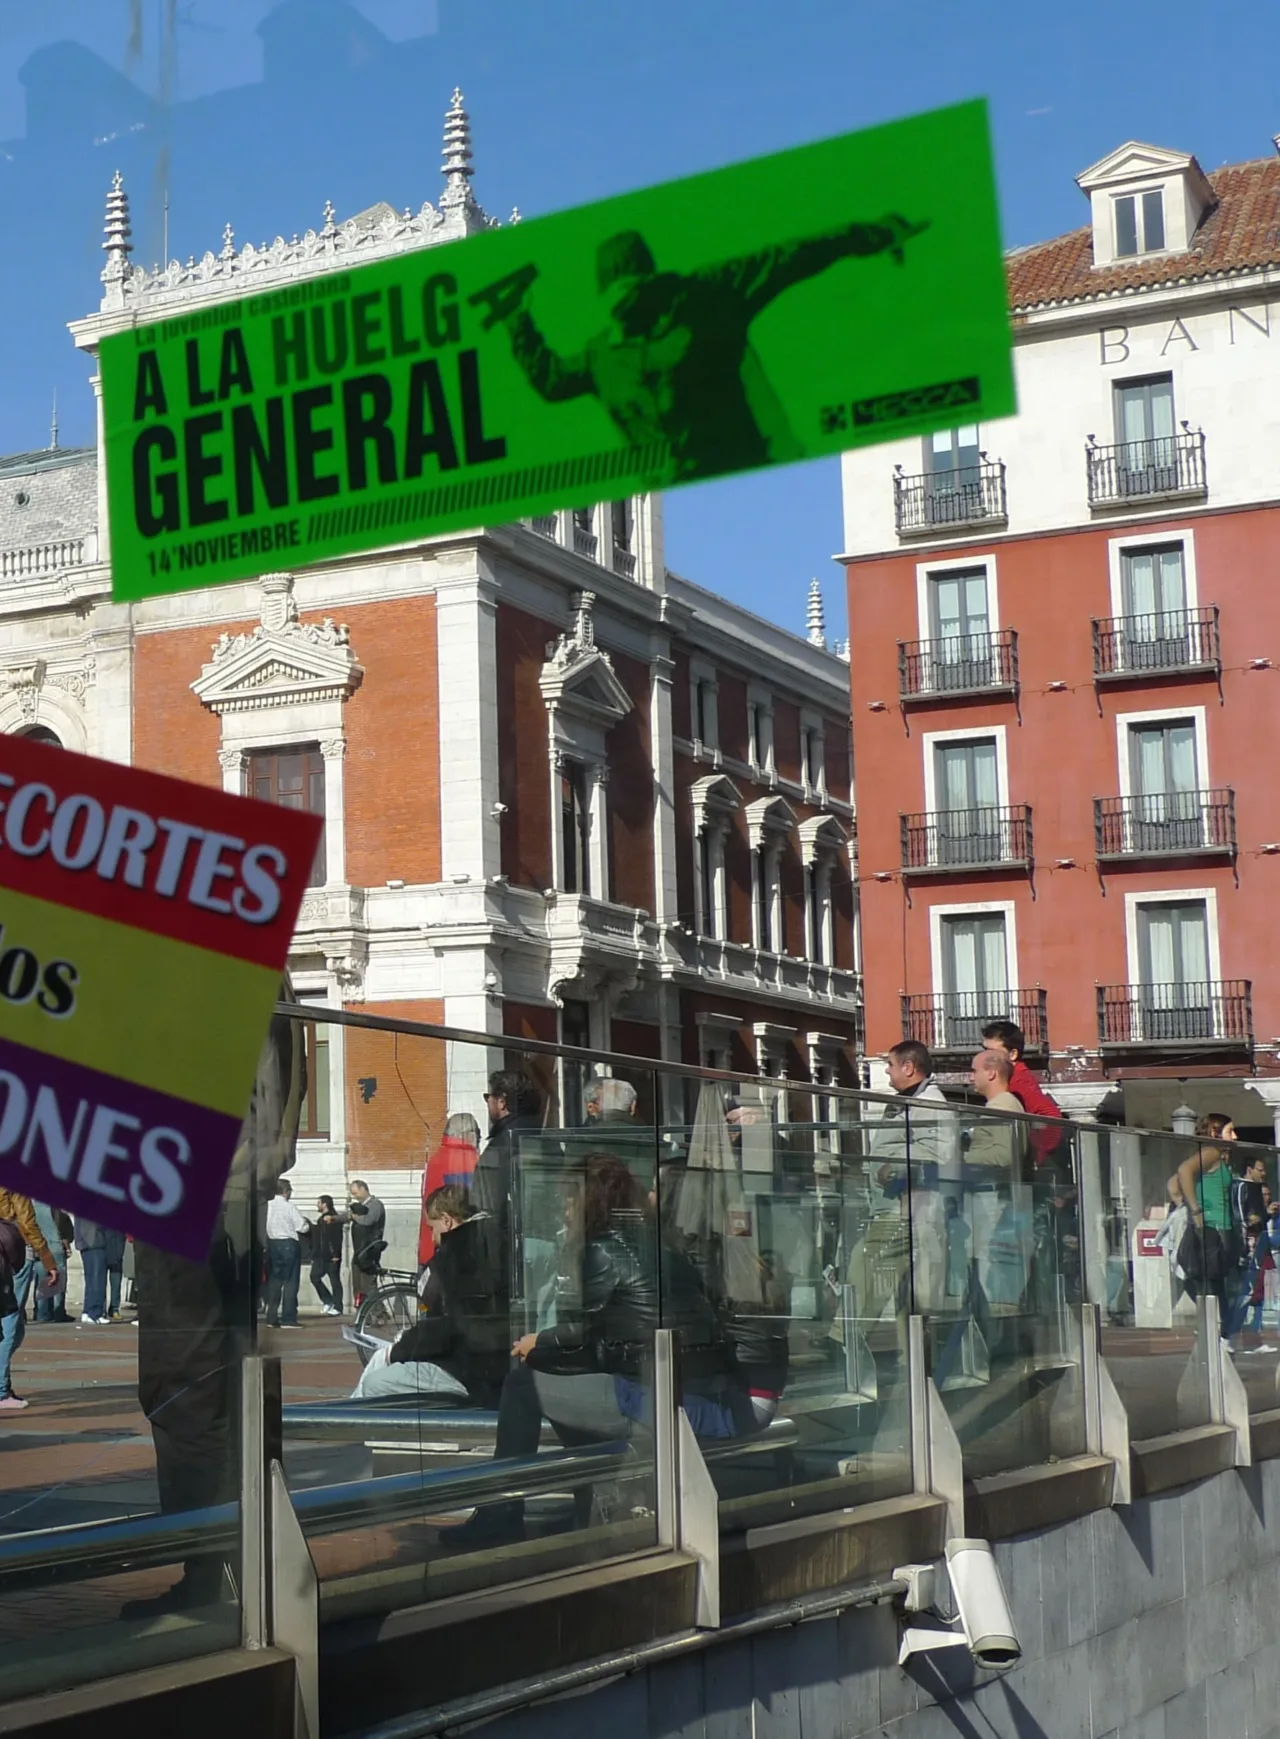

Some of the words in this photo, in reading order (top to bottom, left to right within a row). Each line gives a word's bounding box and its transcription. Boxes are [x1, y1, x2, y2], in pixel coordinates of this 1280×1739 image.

[133, 350, 168, 422] A
[185, 327, 254, 408] LA
[1099, 302, 1271, 366] BAN
[132, 349, 507, 540] GENERAL
